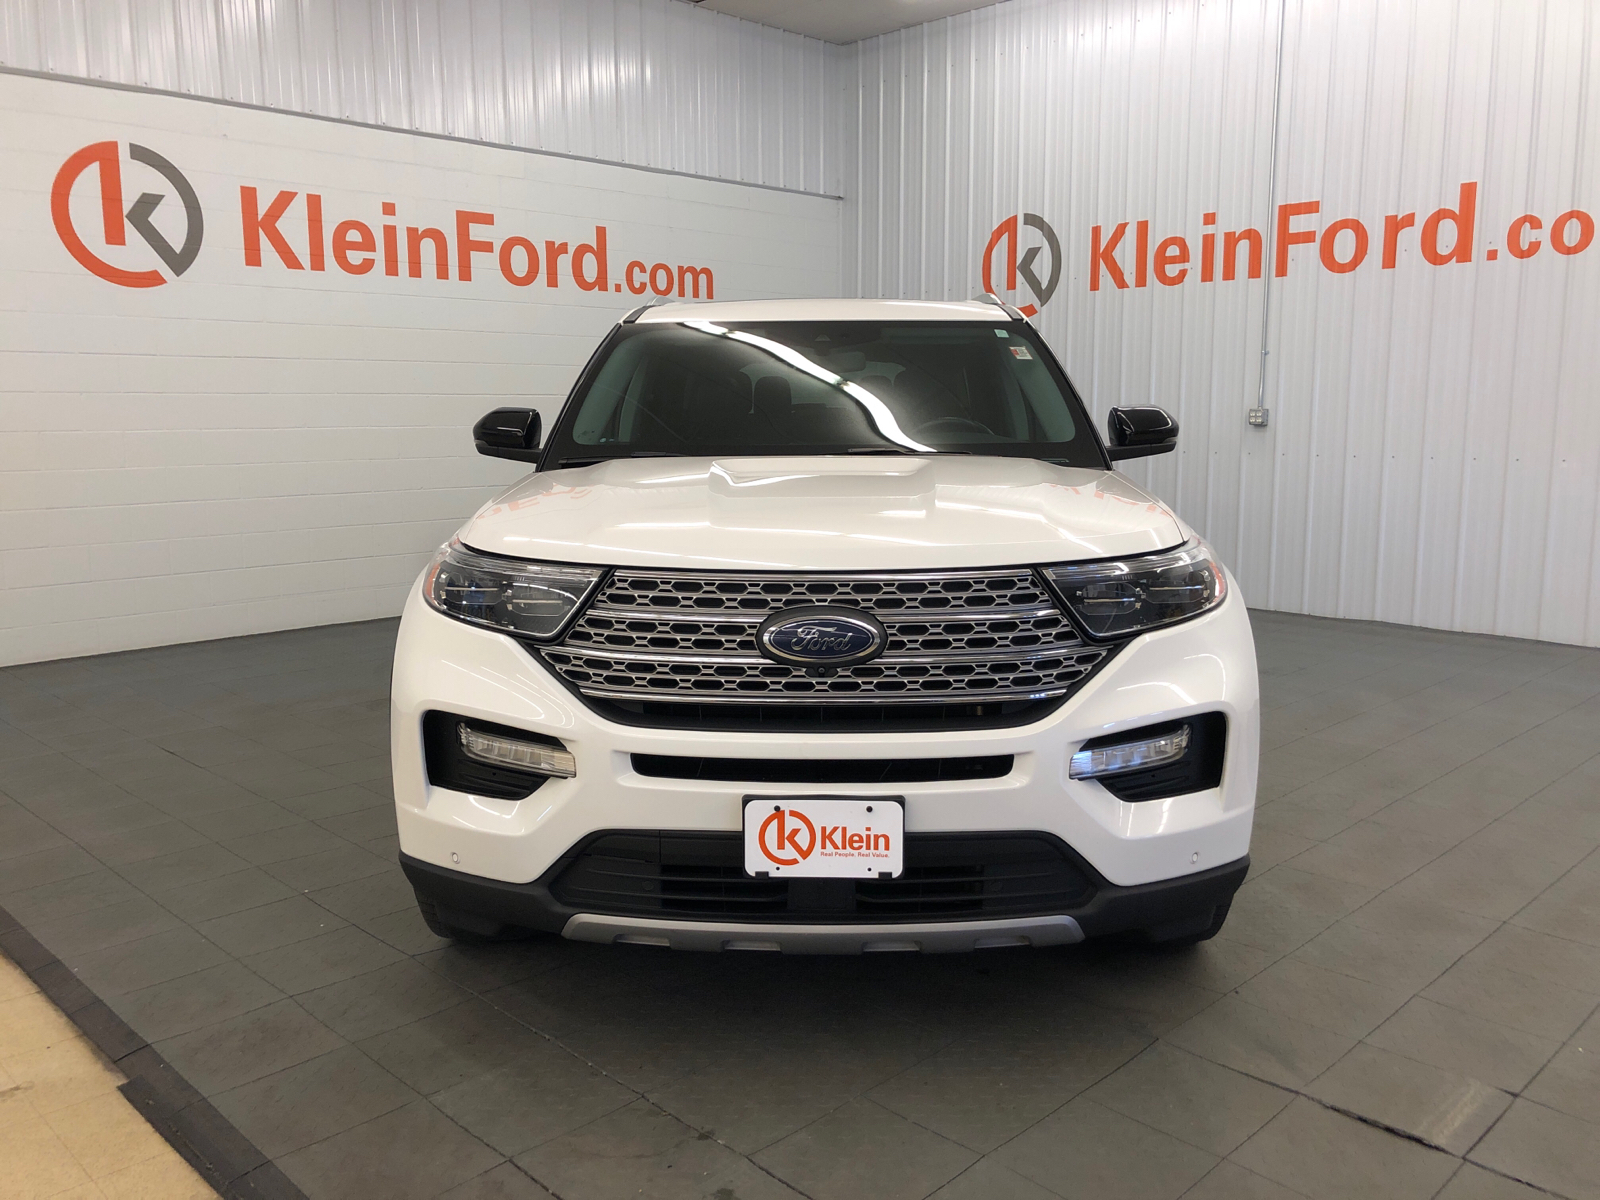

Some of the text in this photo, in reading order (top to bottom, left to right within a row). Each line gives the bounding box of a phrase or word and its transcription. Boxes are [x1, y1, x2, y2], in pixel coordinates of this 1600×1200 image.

[239, 184, 714, 300] KleinFord.com
[1089, 181, 1595, 292] KleinFord.co
[790, 624, 853, 652] Ford
[820, 826, 890, 851] Klein
